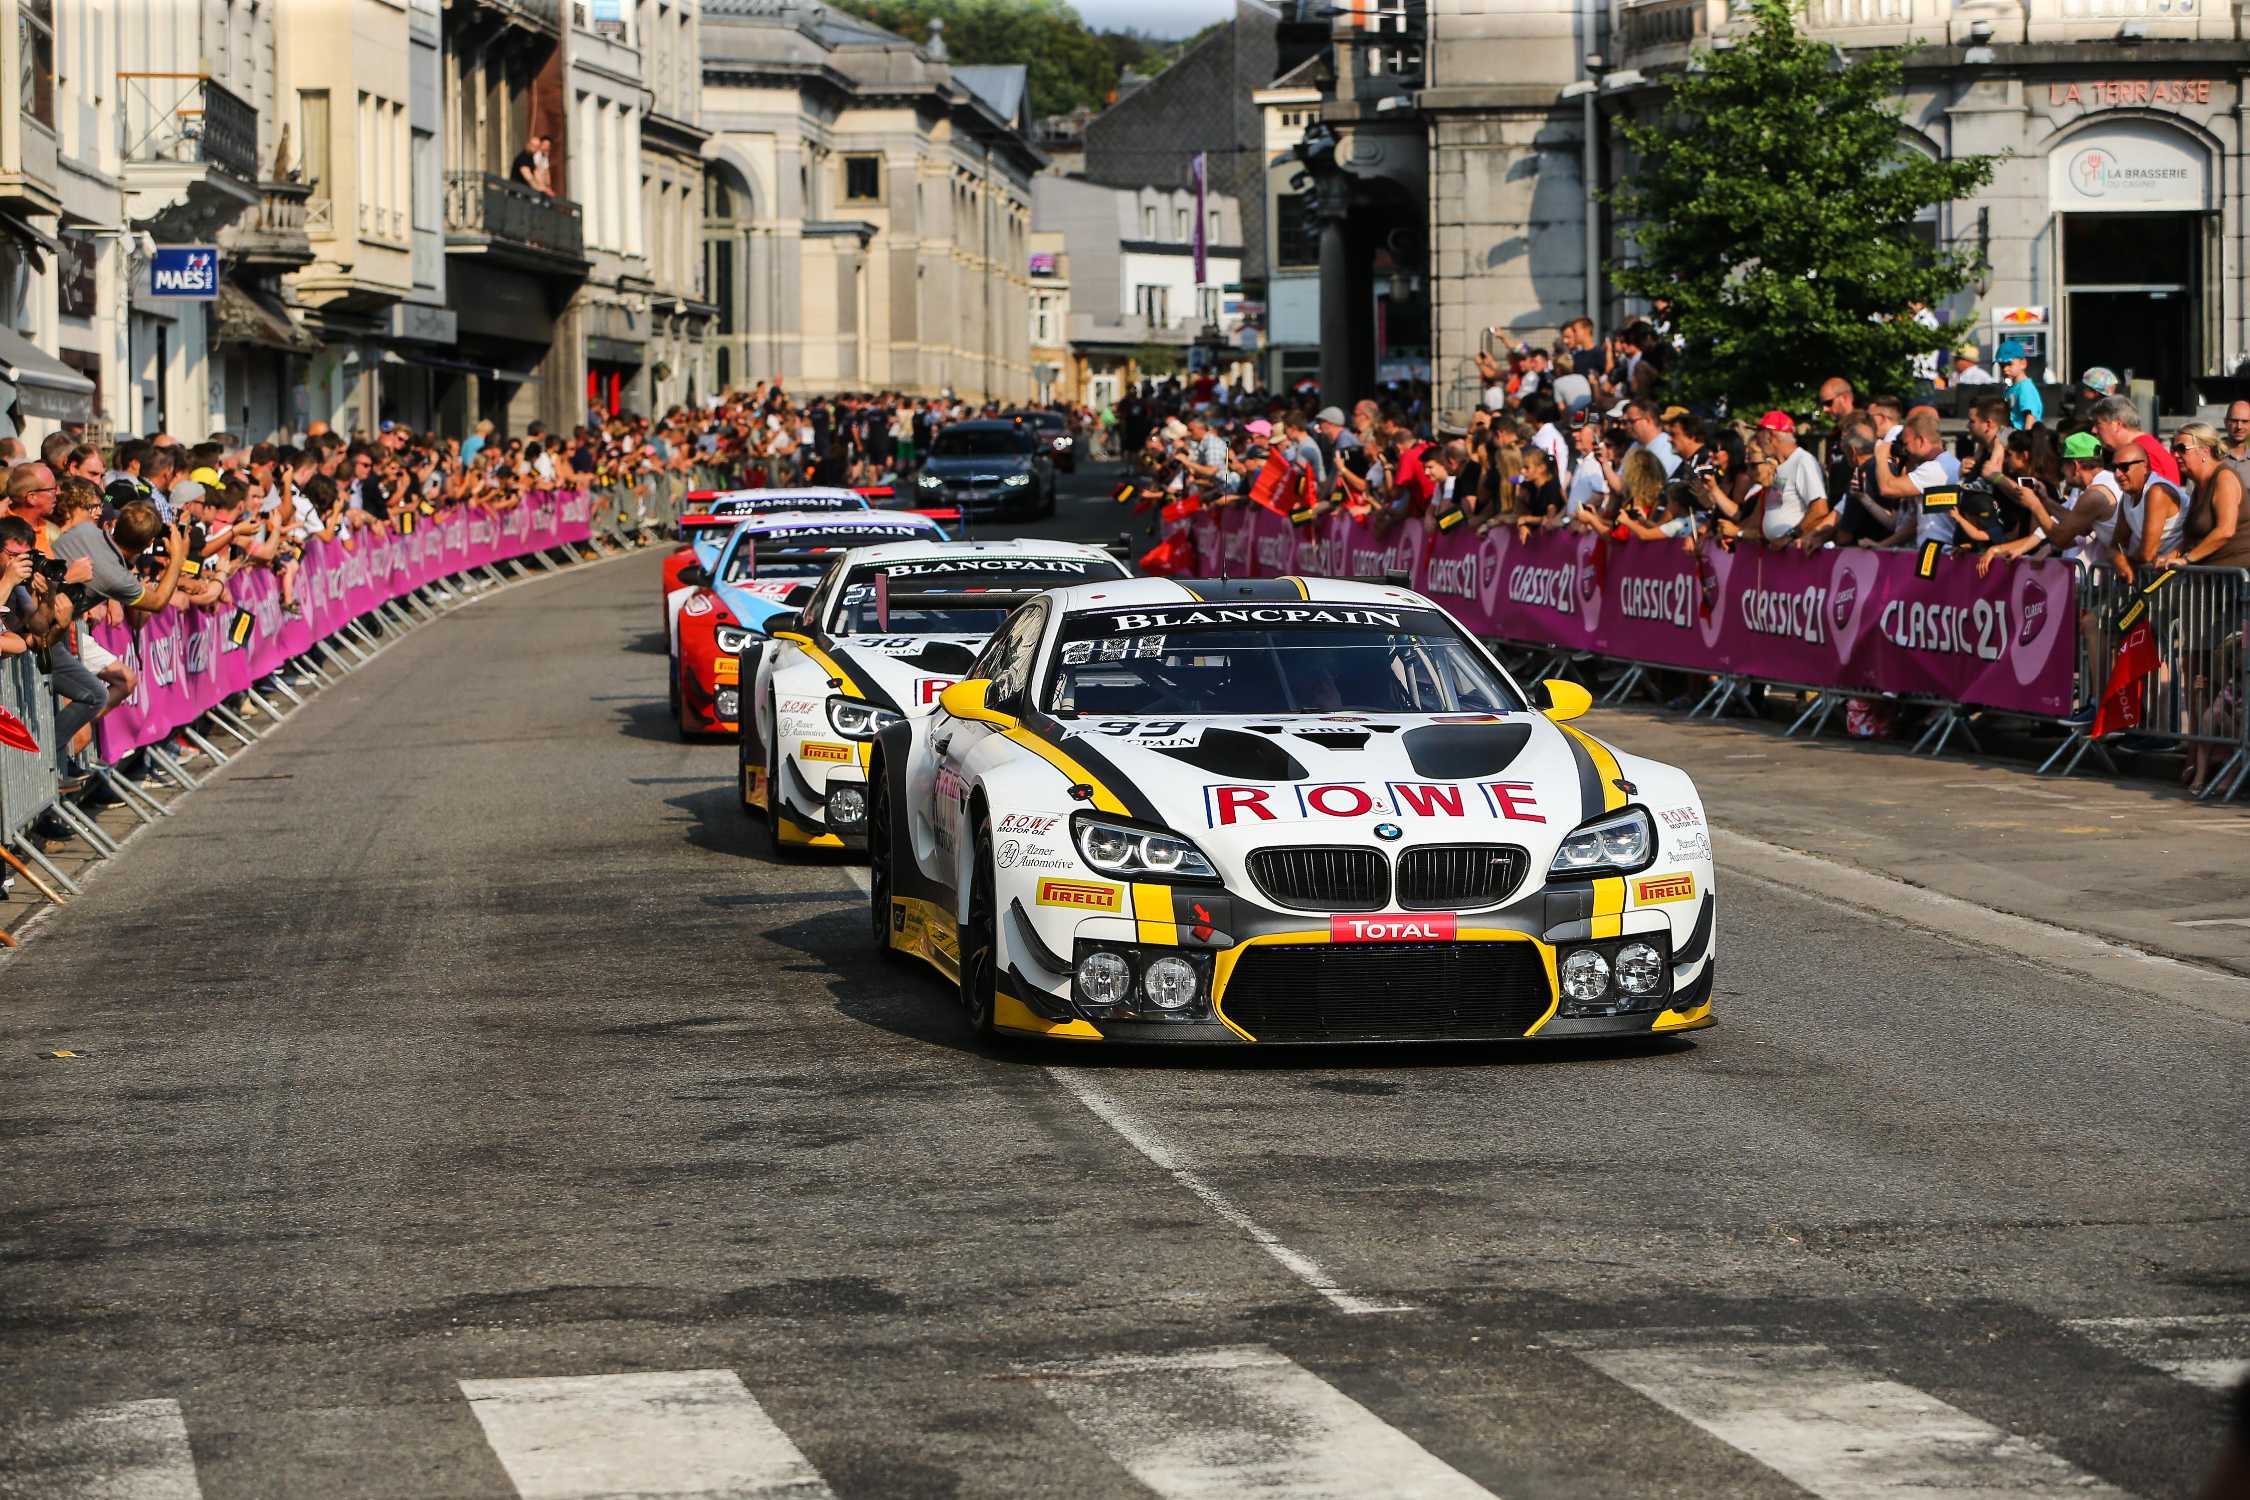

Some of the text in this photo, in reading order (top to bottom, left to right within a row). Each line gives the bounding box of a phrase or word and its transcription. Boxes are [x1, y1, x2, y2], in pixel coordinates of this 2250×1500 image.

[2050, 80, 2210, 106] LA TERRASSE
[2107, 168, 2188, 179] LA BRASSERIE
[156, 270, 205, 289] MAES
[735, 499, 842, 509] BLANCPAIN
[769, 525, 916, 539] BLANCPAIN
[885, 561, 1086, 577] BLANCPAIN
[1428, 558, 1462, 594] CLASSIC
[1463, 552, 1477, 600] 21
[1509, 564, 1558, 607] CLASSIC
[1558, 563, 1575, 613] 21
[1620, 576, 1673, 621] CLASSIC
[1673, 573, 1693, 627] 21
[1112, 609, 1402, 631] BLANCPAIN
[1741, 585, 1827, 644] CLASSIC 21
[1880, 598, 2007, 661] CLASSIC 21
[780, 700, 817, 711] ROWE
[1098, 721, 1187, 737] 99
[804, 744, 848, 760] PIRELLI
[1216, 783, 1547, 826] ROWE
[1001, 814, 1058, 831] ROWE
[1659, 807, 1699, 825] ROWE
[997, 826, 1045, 836] MOTOR OIL
[1020, 844, 1054, 856] Alzner
[1015, 857, 1073, 869] Automotive
[1043, 882, 1114, 907] PIRELLI
[1640, 877, 1691, 900] PIRELLI
[1349, 920, 1440, 938] TOTAL
